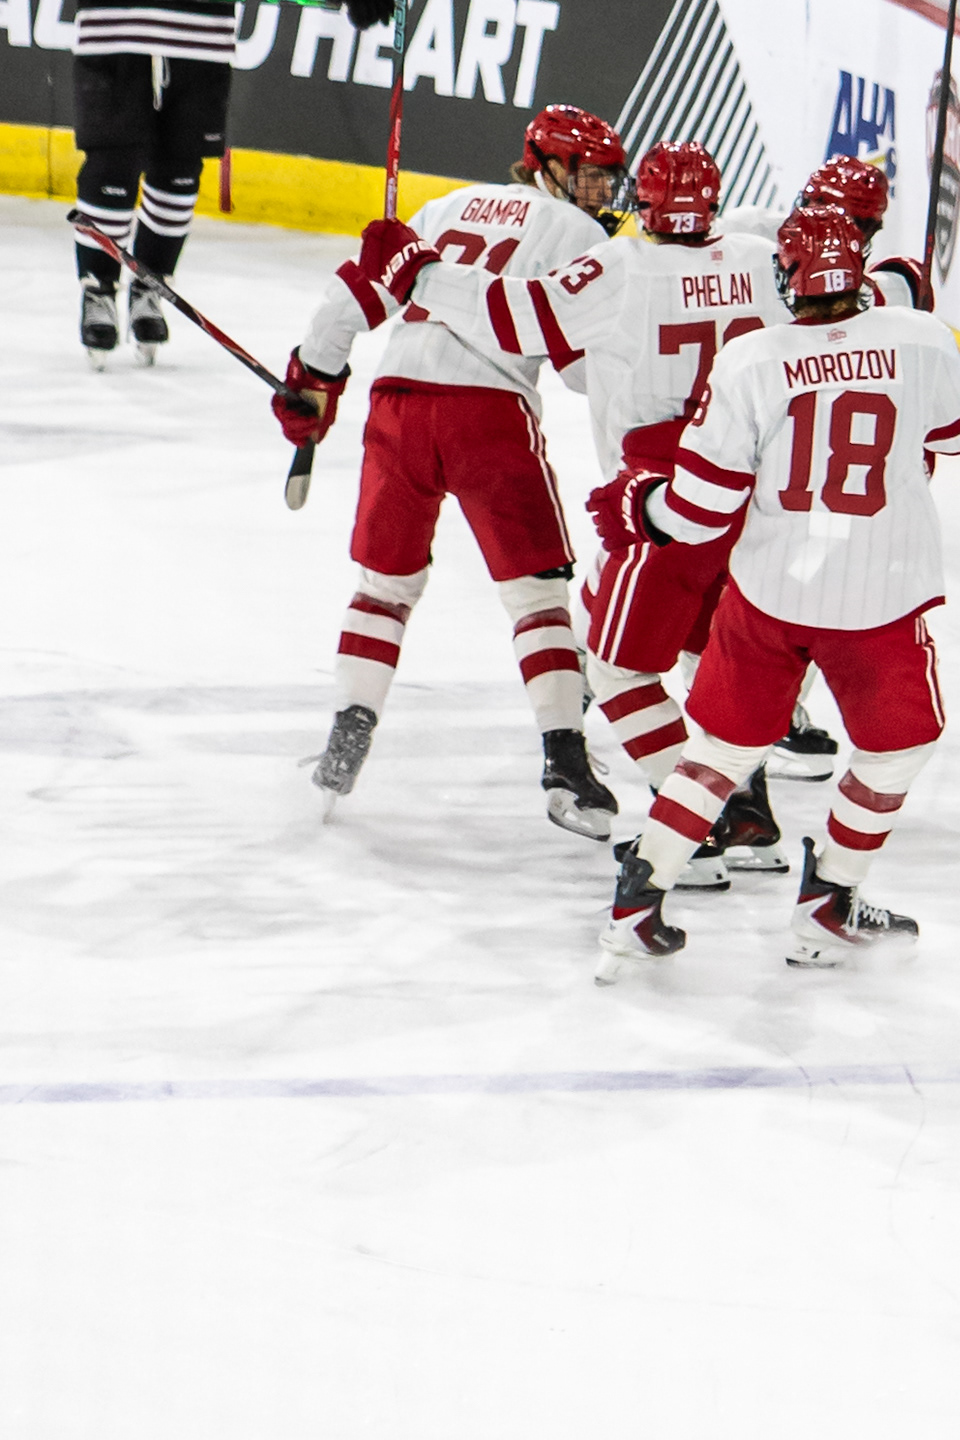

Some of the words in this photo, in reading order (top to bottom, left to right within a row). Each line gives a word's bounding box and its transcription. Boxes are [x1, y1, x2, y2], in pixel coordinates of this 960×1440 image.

[460, 197, 532, 228] GIAMPA
[670, 214, 695, 234] 73
[682, 272, 752, 308] PHELAN
[824, 271, 845, 293] 18
[783, 348, 896, 389] MOROZOV
[778, 390, 898, 517] 18
